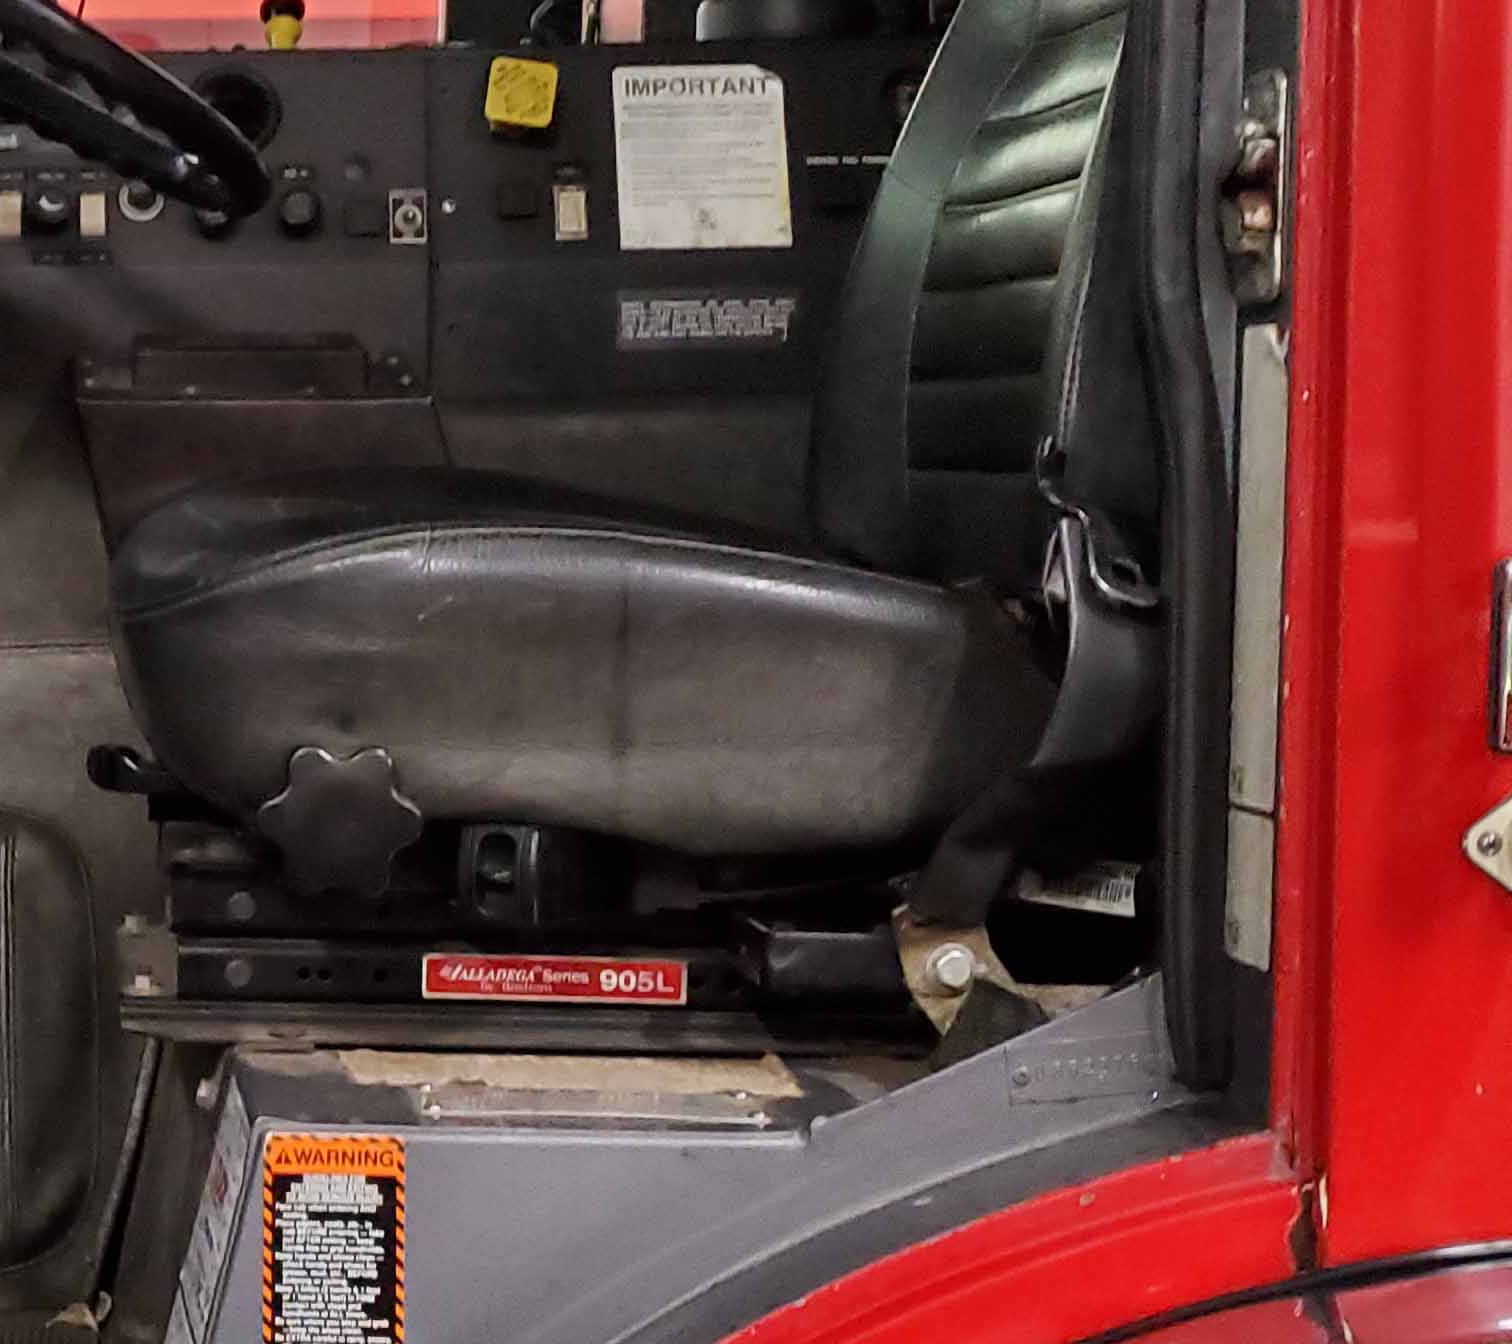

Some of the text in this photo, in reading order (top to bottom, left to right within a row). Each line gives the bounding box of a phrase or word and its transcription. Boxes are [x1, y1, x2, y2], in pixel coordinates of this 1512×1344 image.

[624, 76, 769, 97] IMPORTANT
[542, 968, 589, 986] Series
[599, 968, 676, 994] 905L
[293, 1148, 395, 1167] WARNING
